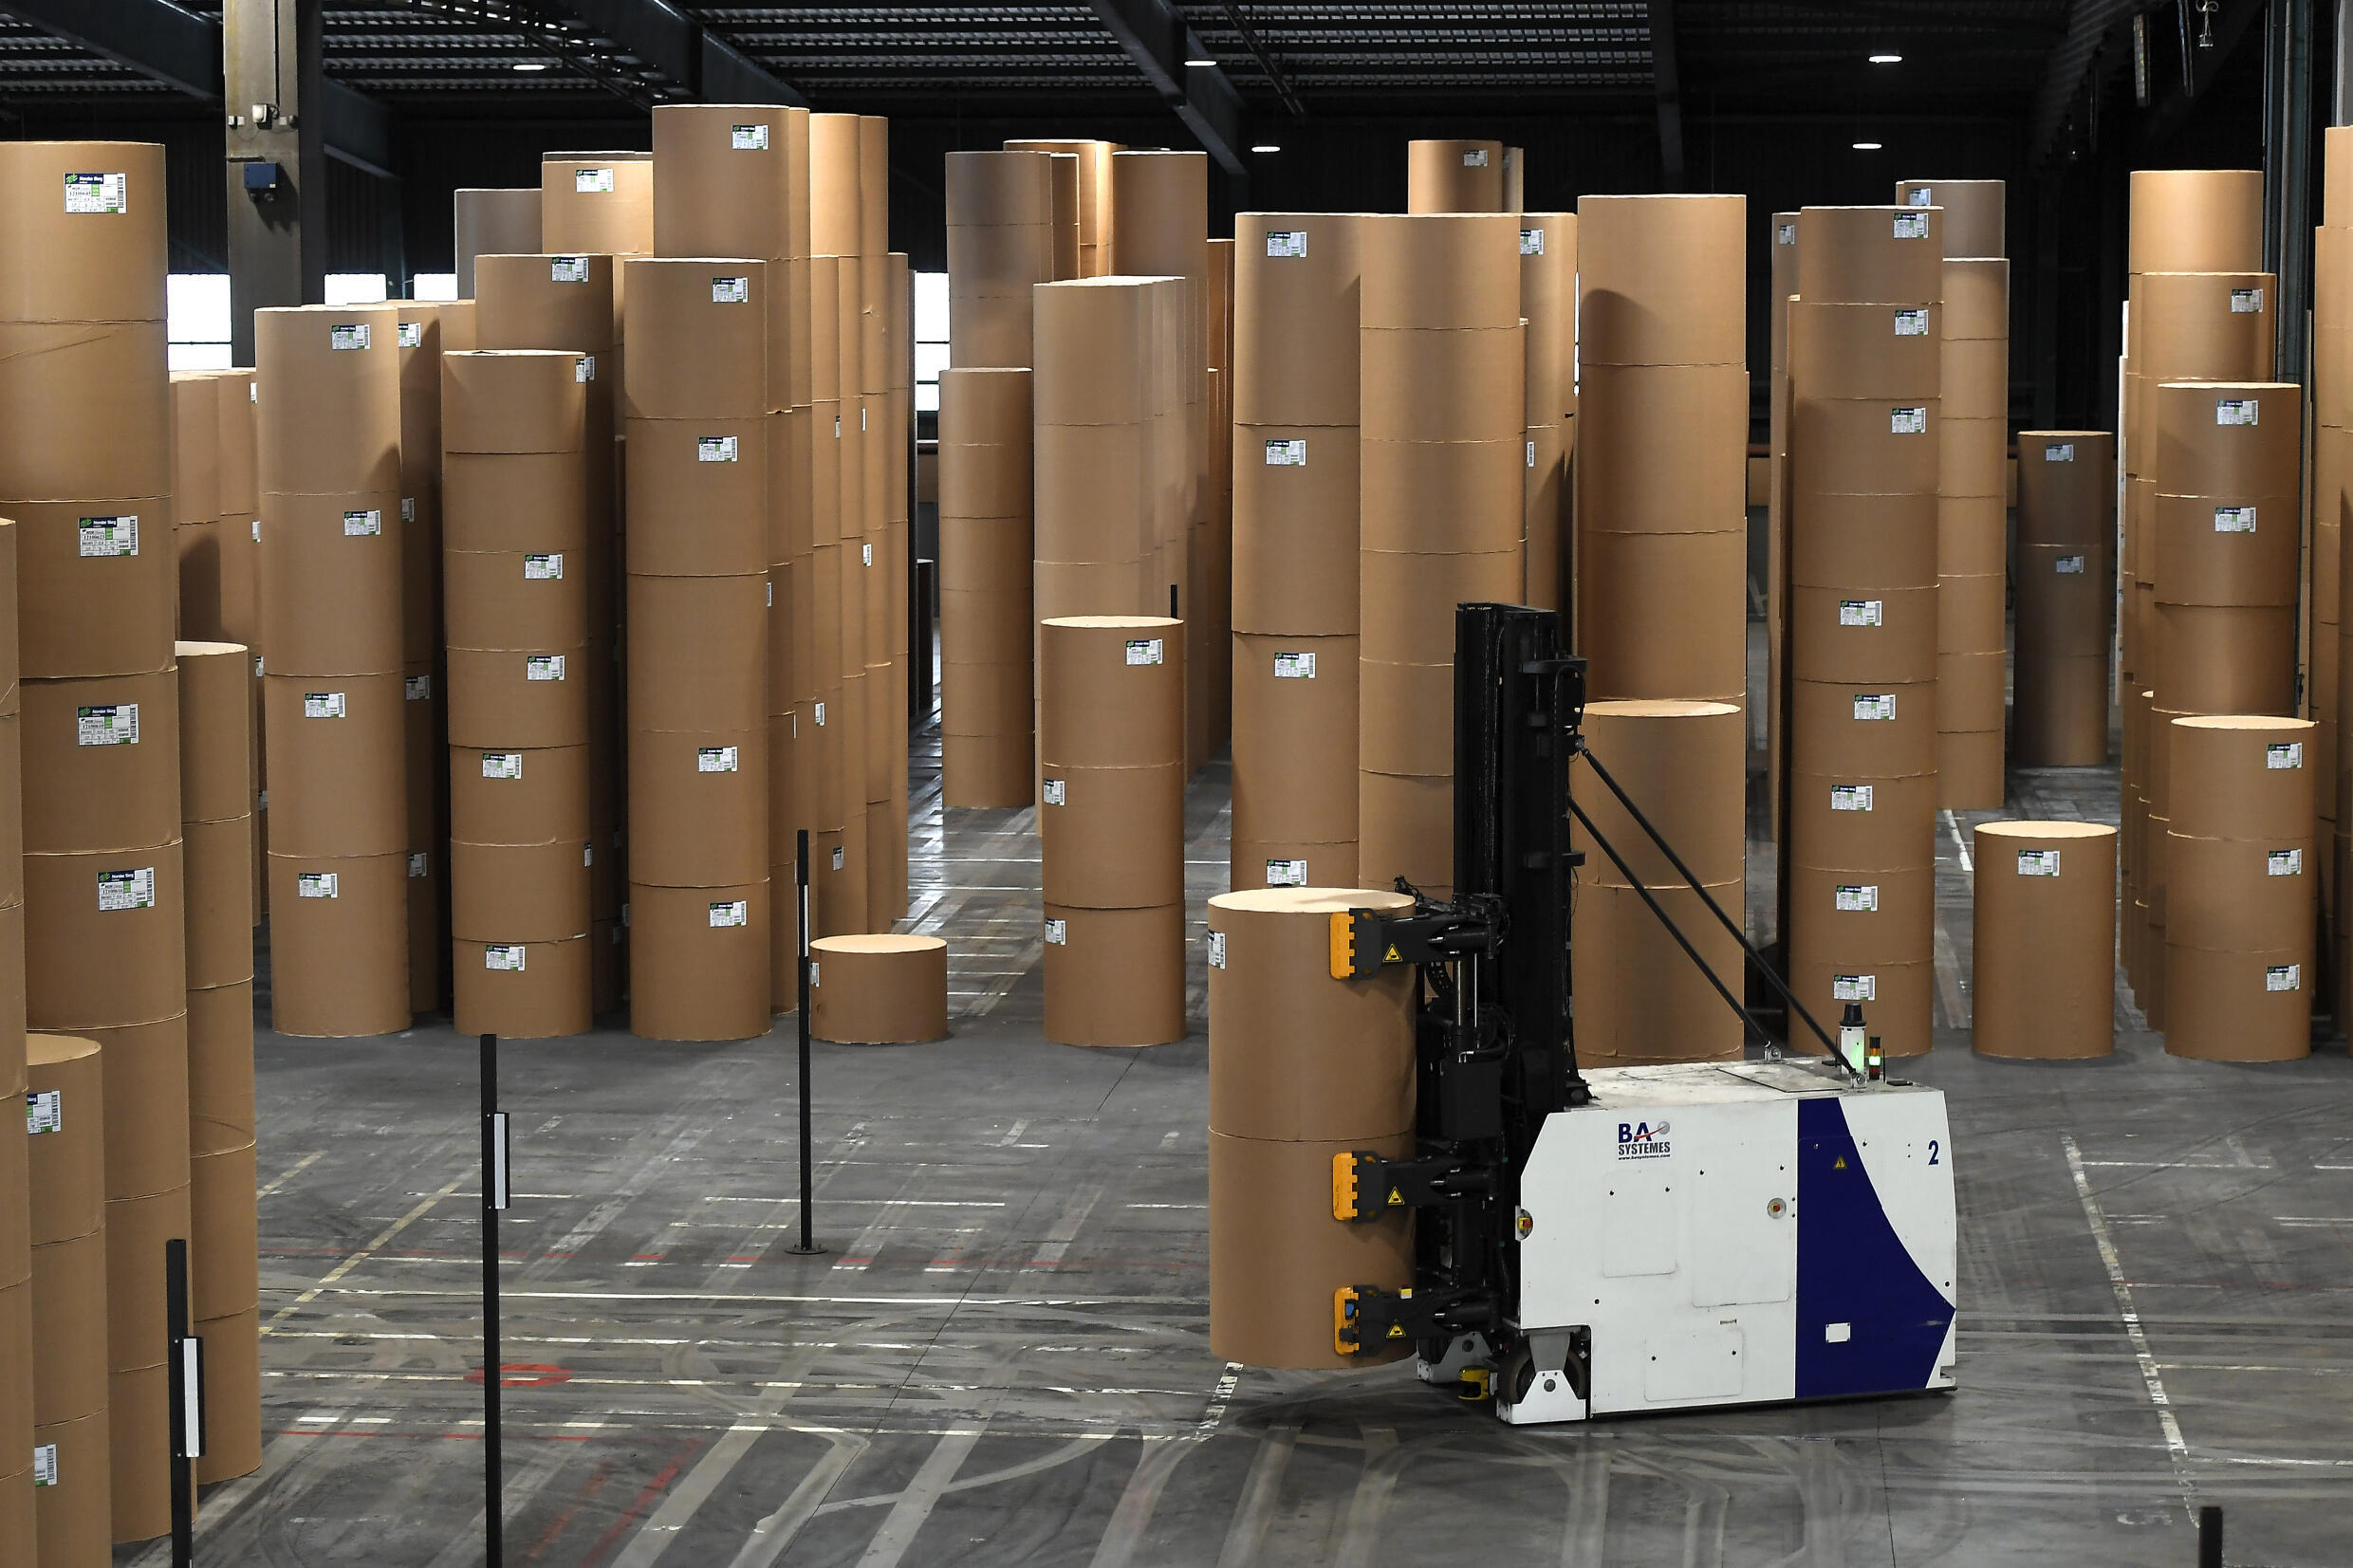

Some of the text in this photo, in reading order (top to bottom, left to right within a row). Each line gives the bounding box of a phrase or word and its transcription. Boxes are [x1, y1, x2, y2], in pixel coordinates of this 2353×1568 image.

[1618, 1121, 1652, 1143] BA
[1618, 1141, 1671, 1155] SYSTEMES
[1928, 1139, 1939, 1165] 2
